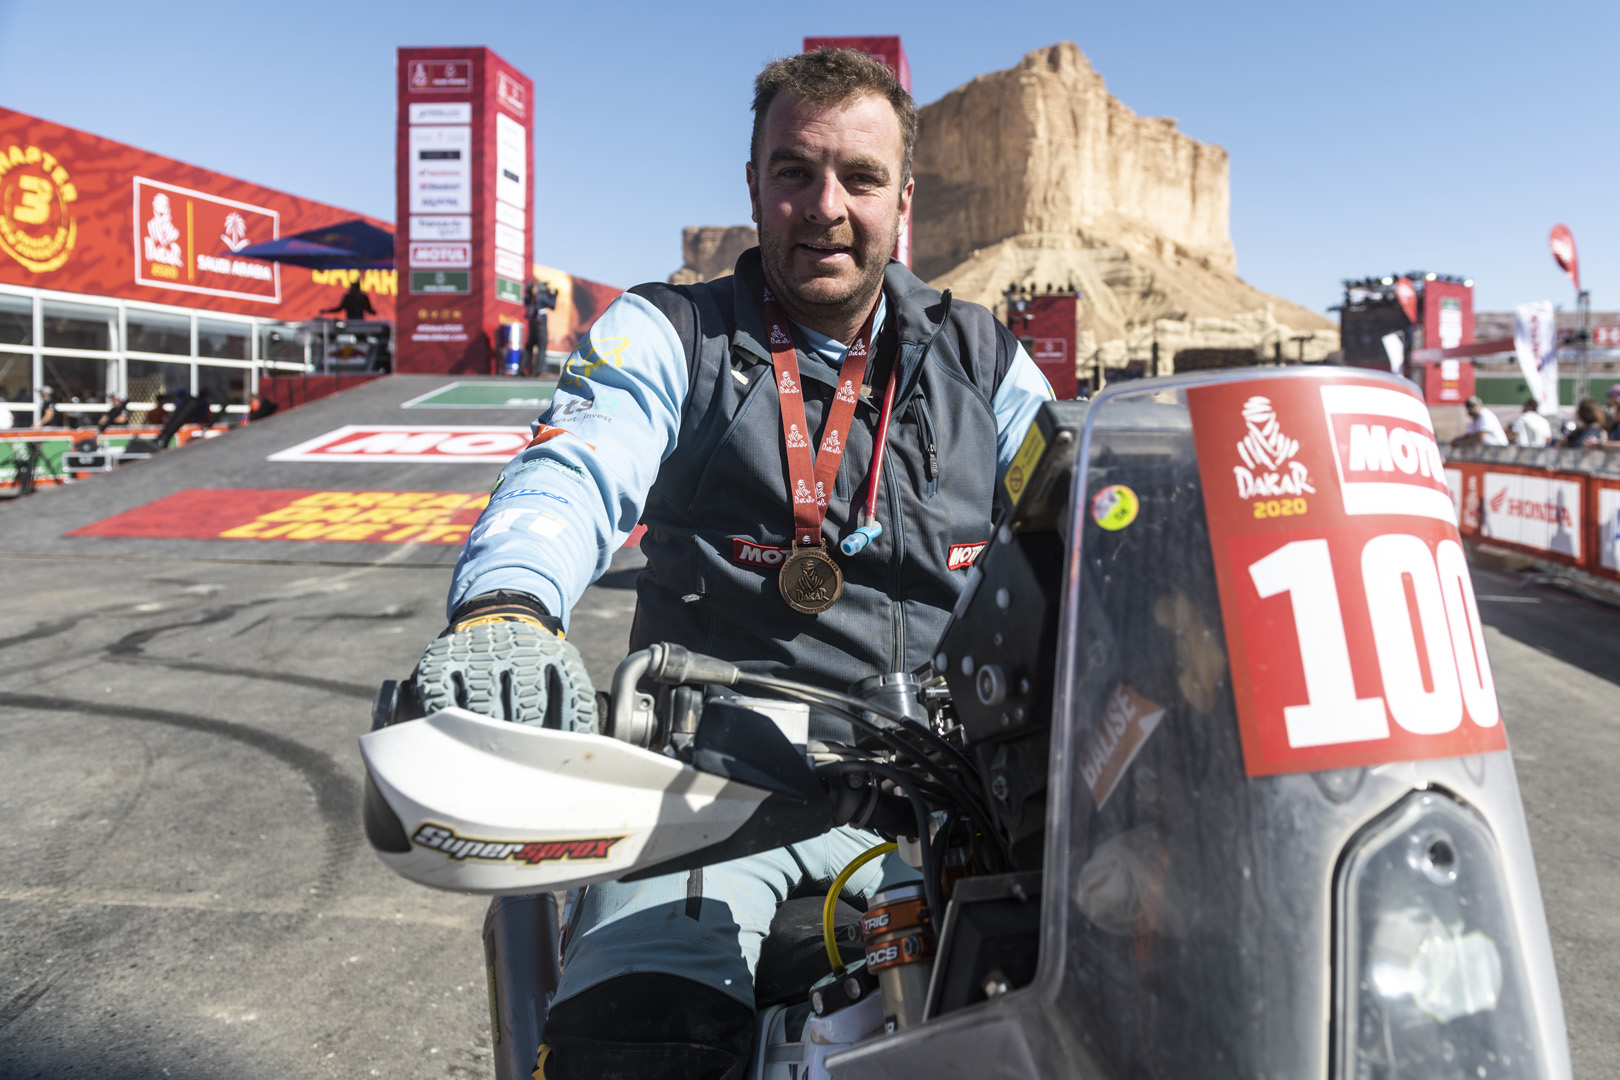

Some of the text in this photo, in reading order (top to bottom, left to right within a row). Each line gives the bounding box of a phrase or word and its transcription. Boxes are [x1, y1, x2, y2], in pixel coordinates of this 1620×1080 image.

[13, 174, 53, 225] 3
[414, 247, 466, 262] MOTUL
[197, 253, 273, 281] SAUDI ARABIA
[779, 386, 800, 394] DAKAR
[836, 391, 856, 403] DAKAR
[583, 412, 613, 423] invest
[325, 432, 534, 454] MO
[787, 440, 808, 448] DAKAR
[821, 442, 842, 455] DAKAR
[1349, 424, 1448, 488] MOTU
[1233, 461, 1317, 500] DAKAR
[794, 495, 815, 504] DAKAR
[1253, 497, 1308, 519] 2020
[1508, 498, 1573, 527] HONDA
[219, 521, 392, 540] LIVE
[796, 587, 830, 603] DAKAR
[1248, 533, 1499, 749] 100
[1079, 684, 1137, 790] BALISE
